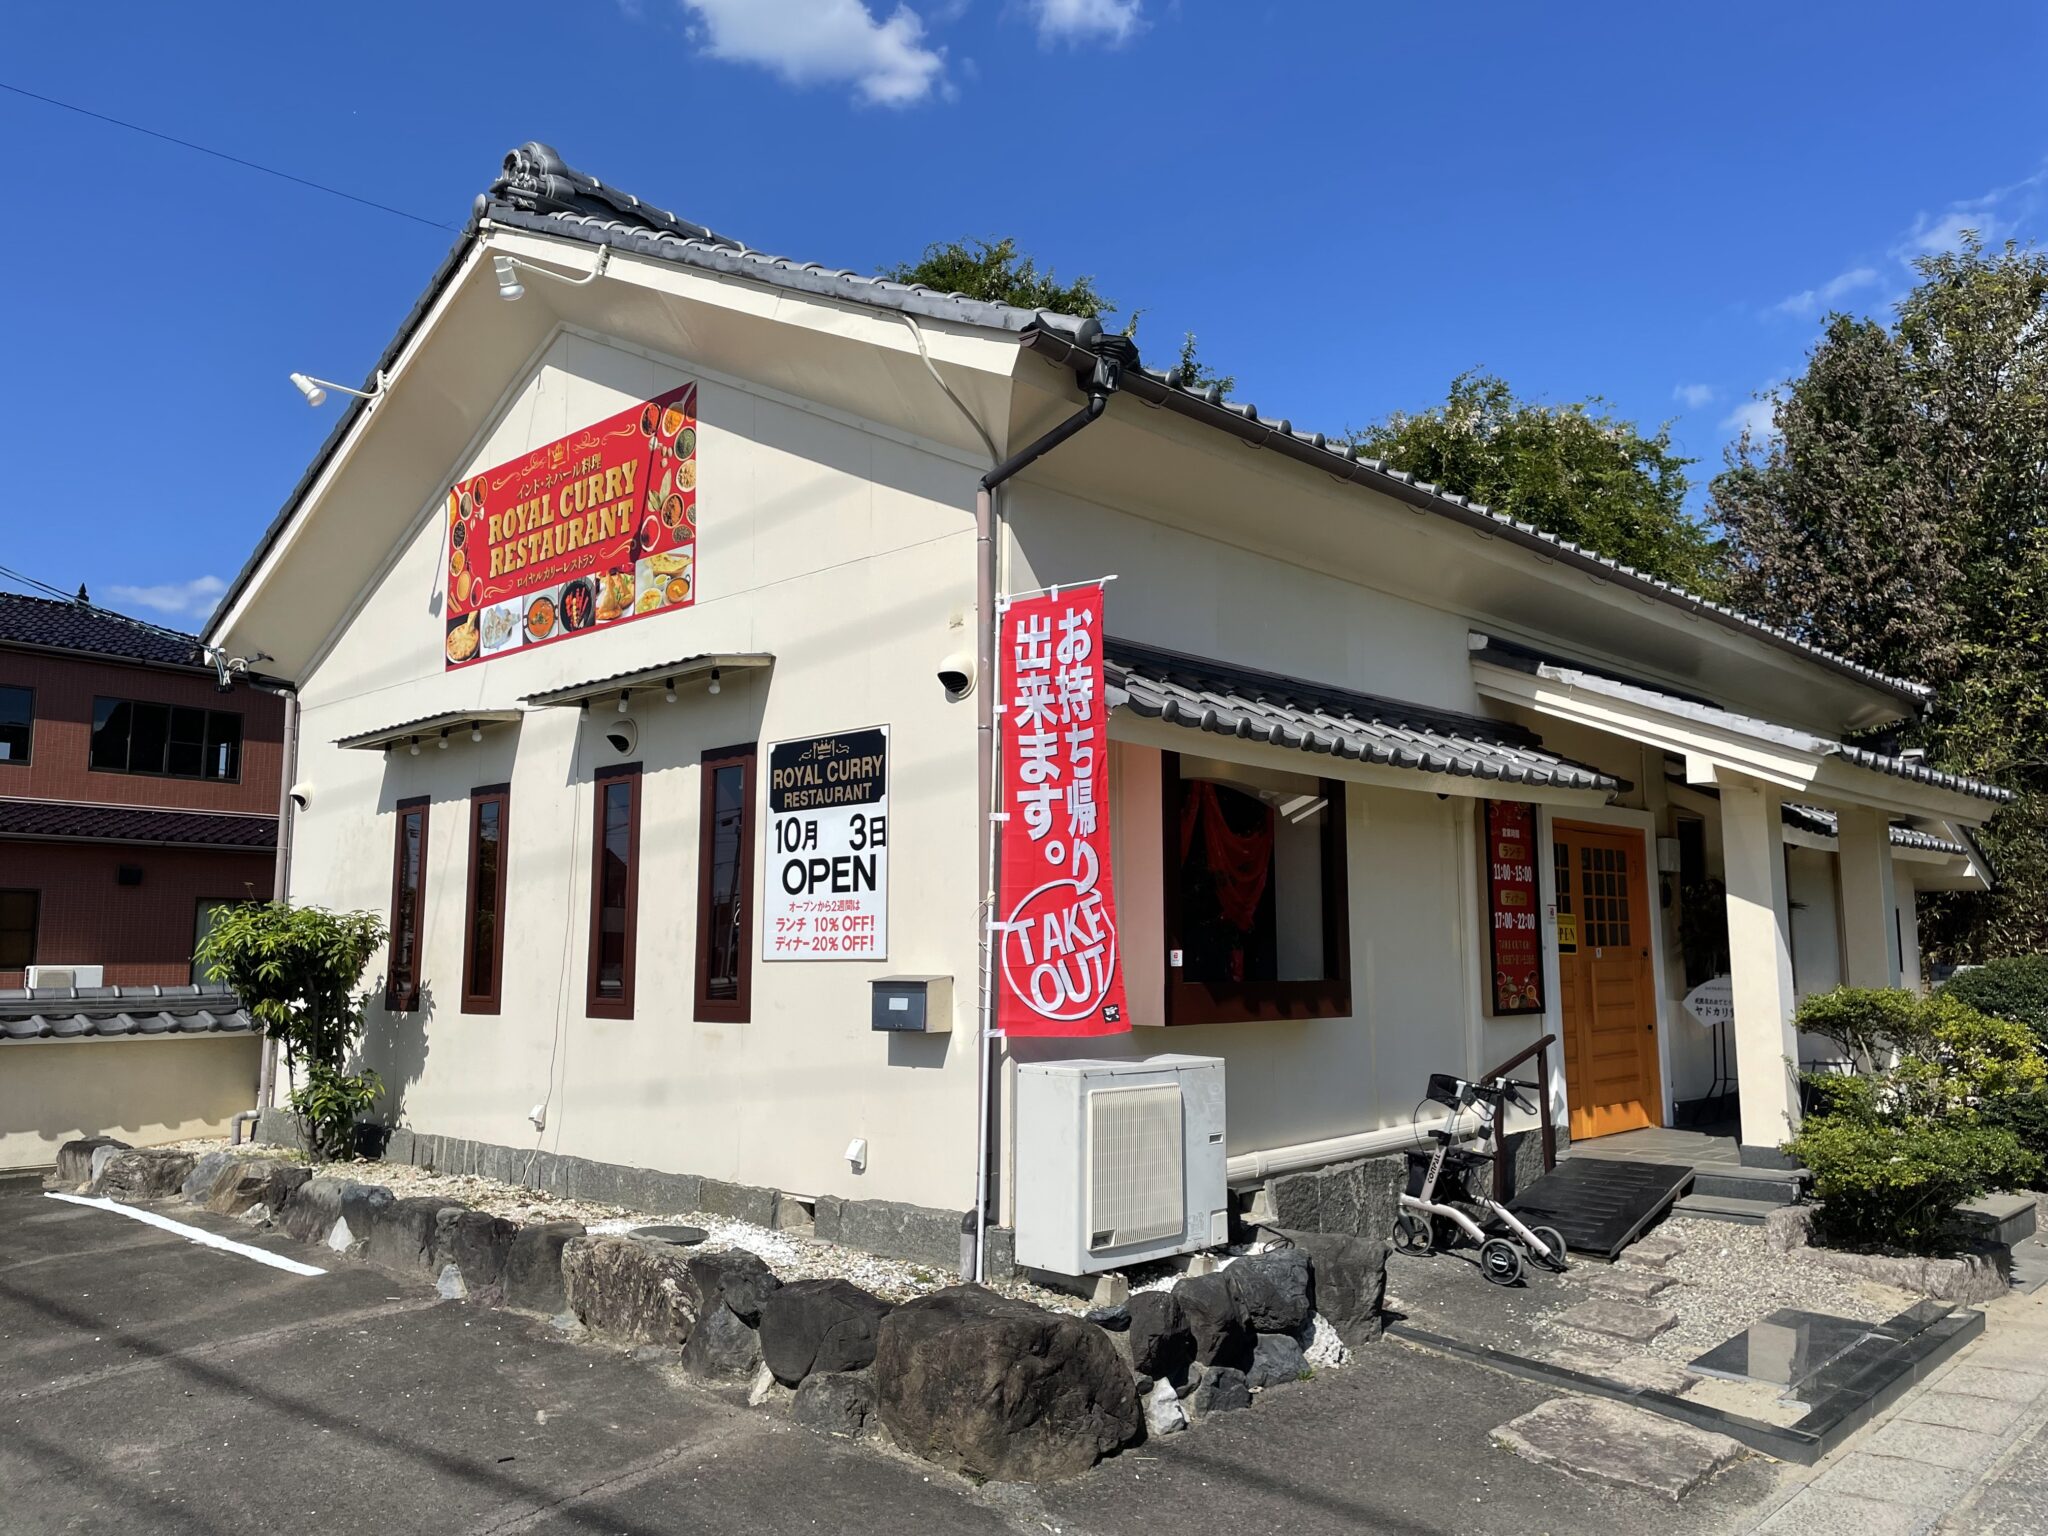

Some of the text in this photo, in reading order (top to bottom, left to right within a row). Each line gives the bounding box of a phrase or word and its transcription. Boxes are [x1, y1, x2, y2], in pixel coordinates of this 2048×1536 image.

[489, 459, 638, 545] ROYAL CURRY
[489, 499, 634, 578] RESTAURANT
[516, 554, 597, 589] ロイヤルカリーレストラン
[1013, 614, 1067, 866] 出来ます。
[1055, 607, 1100, 895] お持ち帰り
[773, 754, 884, 789] ROYAL CURRY
[784, 782, 872, 808] RESTAURANT
[775, 813, 886, 853] 10月 3日
[782, 854, 876, 895] OPEN
[776, 915, 875, 932] ランチ 10% OFF!
[789, 899, 860, 912] オープンから2週間は
[776, 934, 875, 951] ディナー 20% OFF!
[1007, 898, 1107, 965] TAKE
[1558, 927, 1575, 941] PEN
[1031, 946, 1106, 1011] OUT
